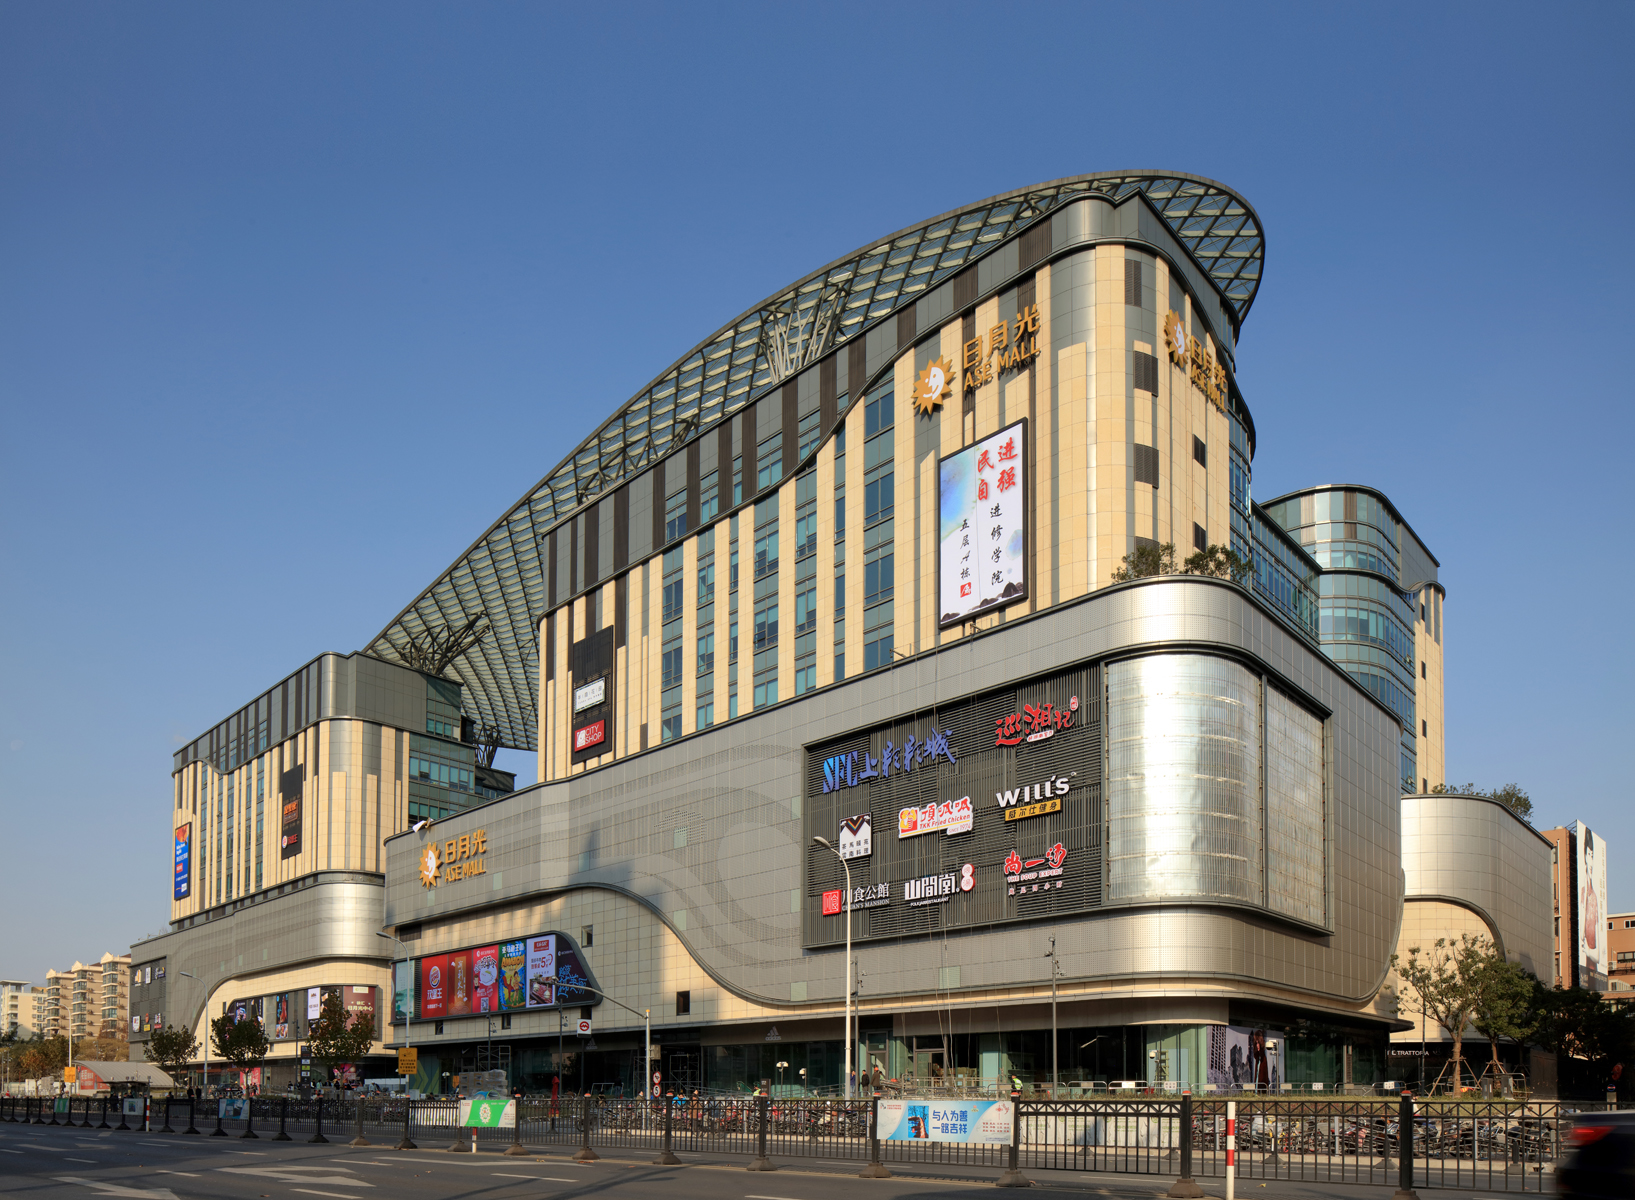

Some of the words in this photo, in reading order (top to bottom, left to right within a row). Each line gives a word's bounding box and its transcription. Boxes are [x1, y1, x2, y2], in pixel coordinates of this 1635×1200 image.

[963, 303, 1040, 369] 日月光
[963, 360, 992, 391] ASE
[997, 336, 1040, 373] MALL
[989, 502, 1004, 586] 进修学院
[585, 724, 599, 736] CITY
[995, 702, 1075, 746] 巡湘记
[585, 731, 602, 744] SHOP
[920, 821, 931, 829] TKK
[931, 818, 947, 827] Fried
[947, 814, 971, 824] Chicken
[445, 829, 487, 864] 日月光
[445, 864, 462, 882] ASE
[462, 858, 486, 878] MALL
[1007, 875, 1020, 883] THE
[1020, 872, 1038, 881] SOUP
[1038, 868, 1063, 878] EXPERT
[864, 898, 890, 908] MANSION
[932, 1109, 968, 1122] 与人为善
[932, 1122, 968, 1134] 一路吉祥
